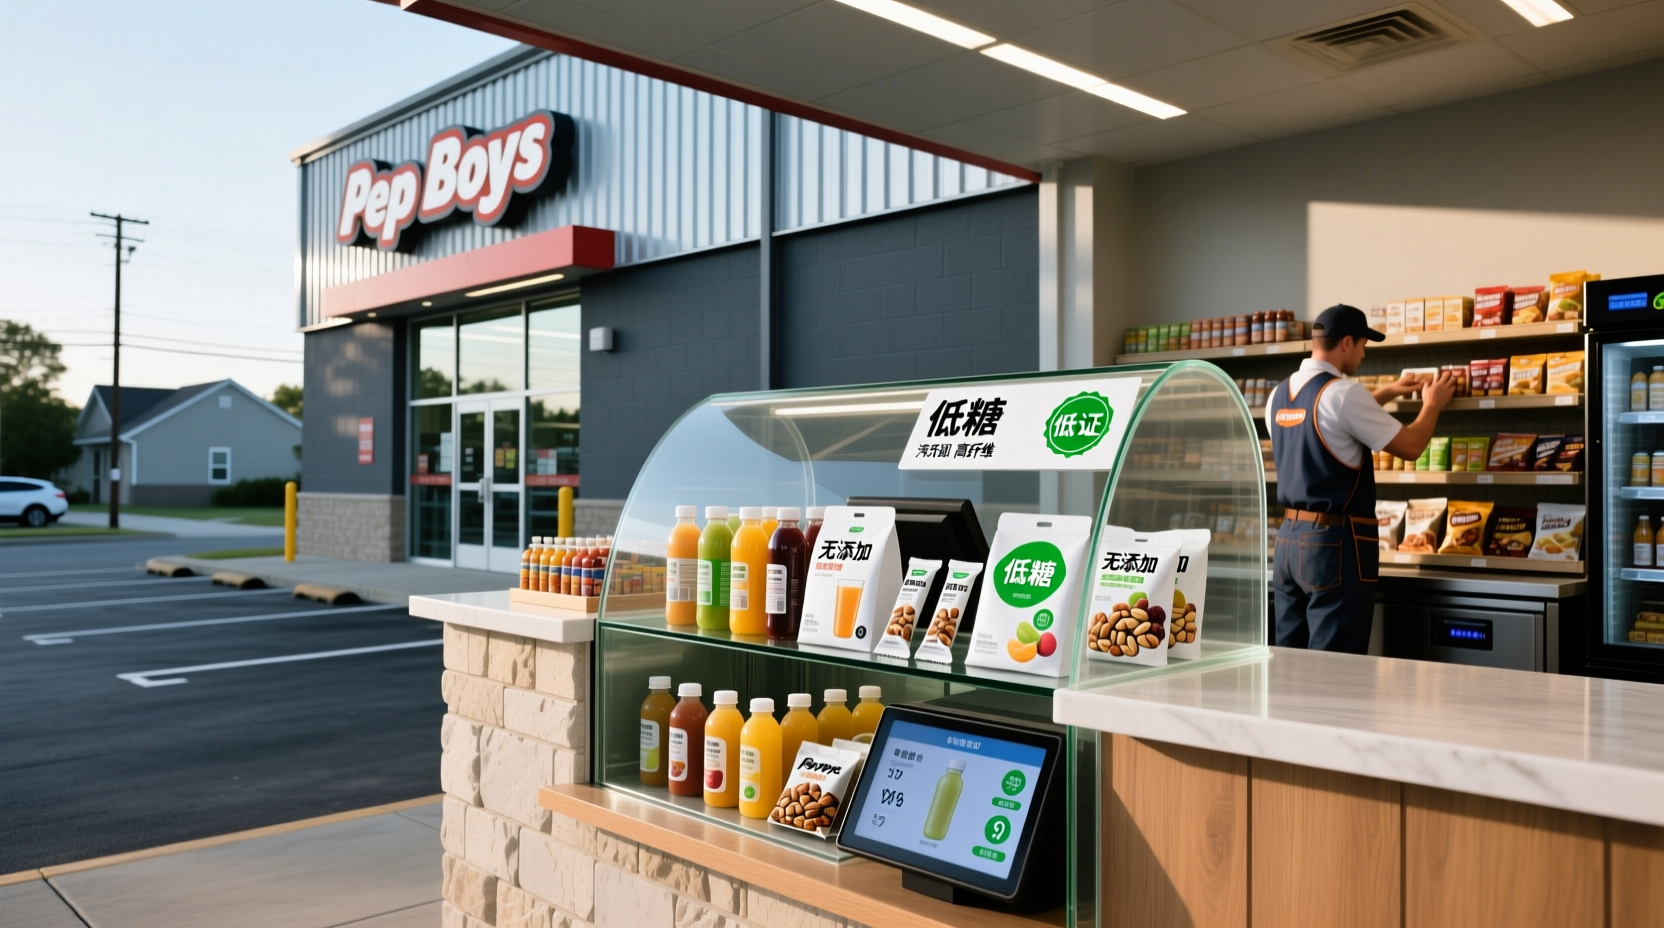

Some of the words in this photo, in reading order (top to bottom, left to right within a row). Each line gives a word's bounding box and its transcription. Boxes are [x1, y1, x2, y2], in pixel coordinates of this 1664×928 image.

[337, 165, 419, 243] Pep
[420, 120, 547, 216] Boys
[926, 396, 1008, 438] 低糖
[1053, 412, 1105, 438] 低证
[817, 539, 873, 561] 无添加
[1101, 551, 1159, 574] 无添加
[1003, 557, 1057, 588] 低糖
